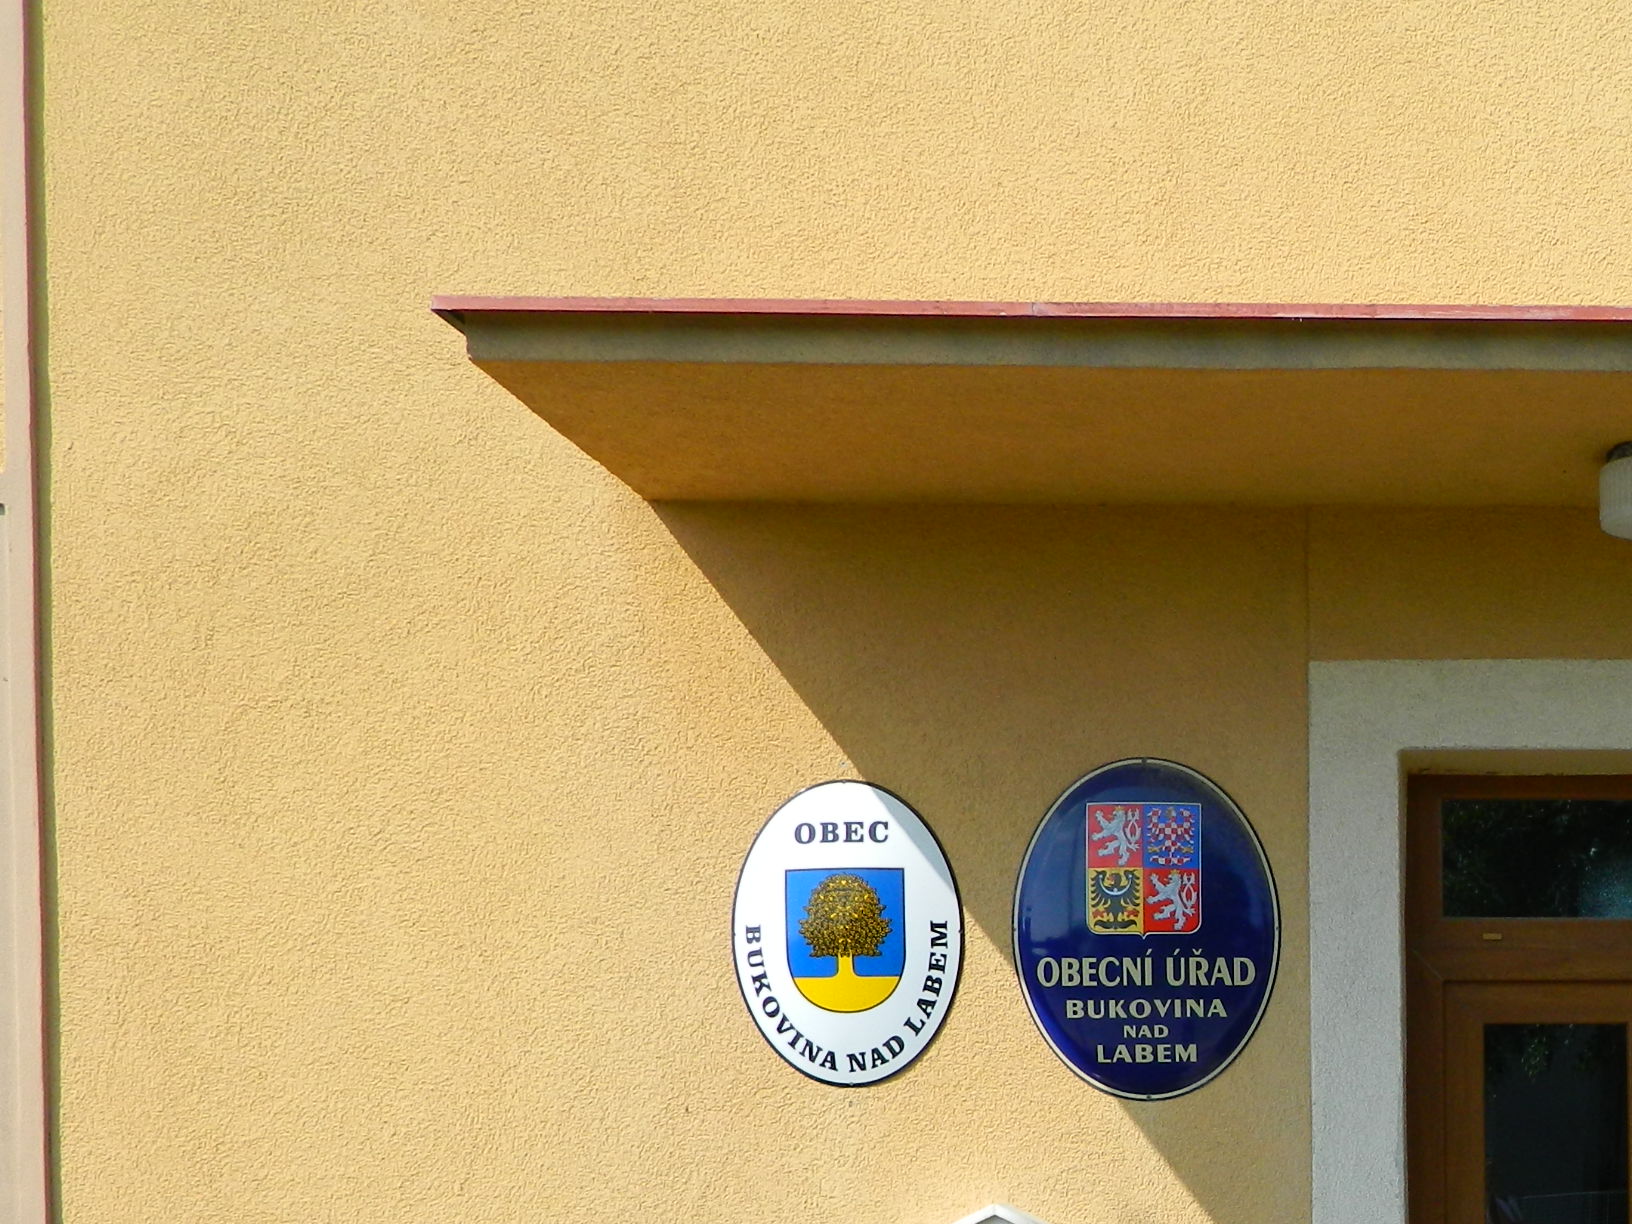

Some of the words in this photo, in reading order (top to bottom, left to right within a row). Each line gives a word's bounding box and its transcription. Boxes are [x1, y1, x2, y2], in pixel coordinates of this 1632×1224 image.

[794, 821, 890, 844] OBEC
[1036, 948, 1153, 987] OBECNÍ
[1166, 948, 1257, 987] ÚŘAD
[745, 924, 839, 1072] BUKOVINA
[847, 1034, 906, 1073] NAD
[903, 920, 948, 1037] LABEM
[1066, 998, 1228, 1019] BUKOVINA
[1123, 1024, 1169, 1039] NAD
[1097, 1043, 1198, 1063] LABEM
